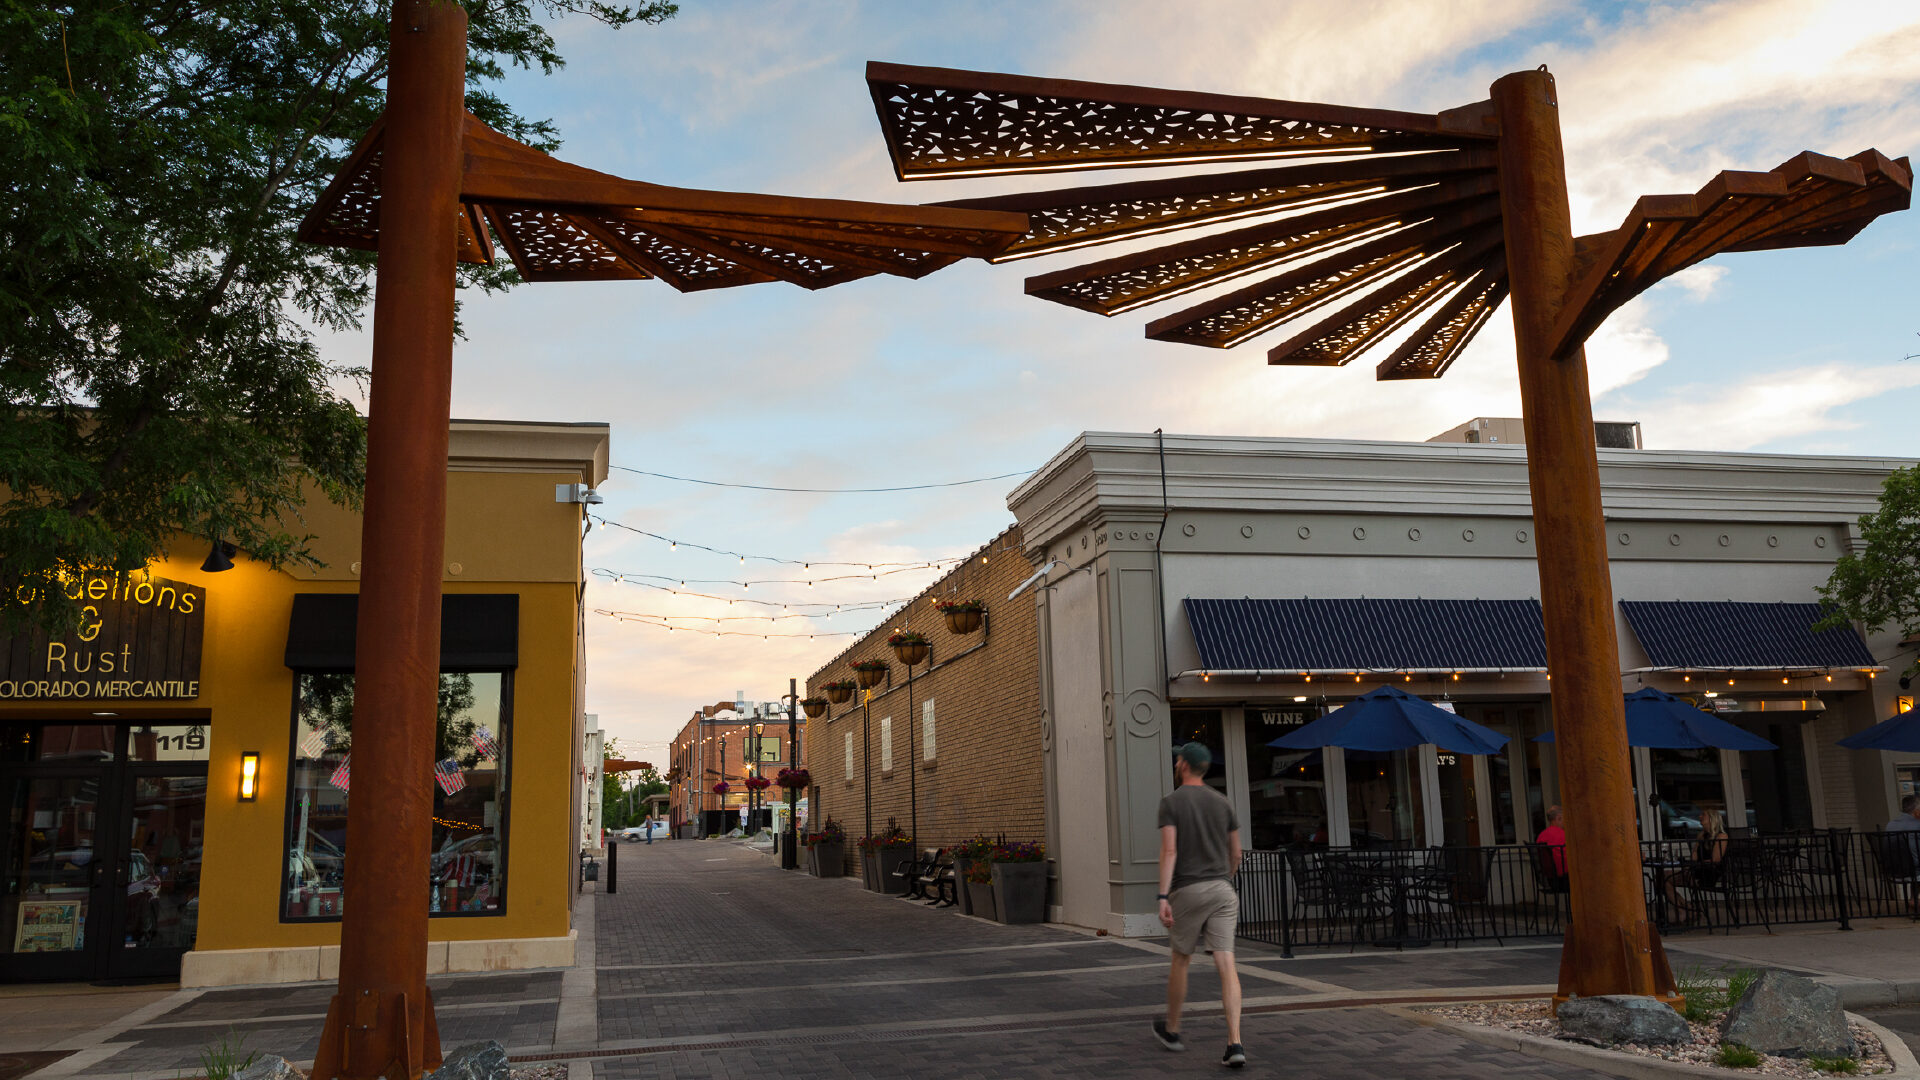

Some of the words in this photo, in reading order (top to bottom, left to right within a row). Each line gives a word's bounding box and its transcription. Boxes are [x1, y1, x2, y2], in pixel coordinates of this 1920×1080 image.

[0, 569, 197, 614] adelions
[46, 642, 132, 673] Rust
[94, 680, 199, 698] MERCANTILE
[1262, 712, 1303, 725] WINE
[156, 735, 205, 751] 119
